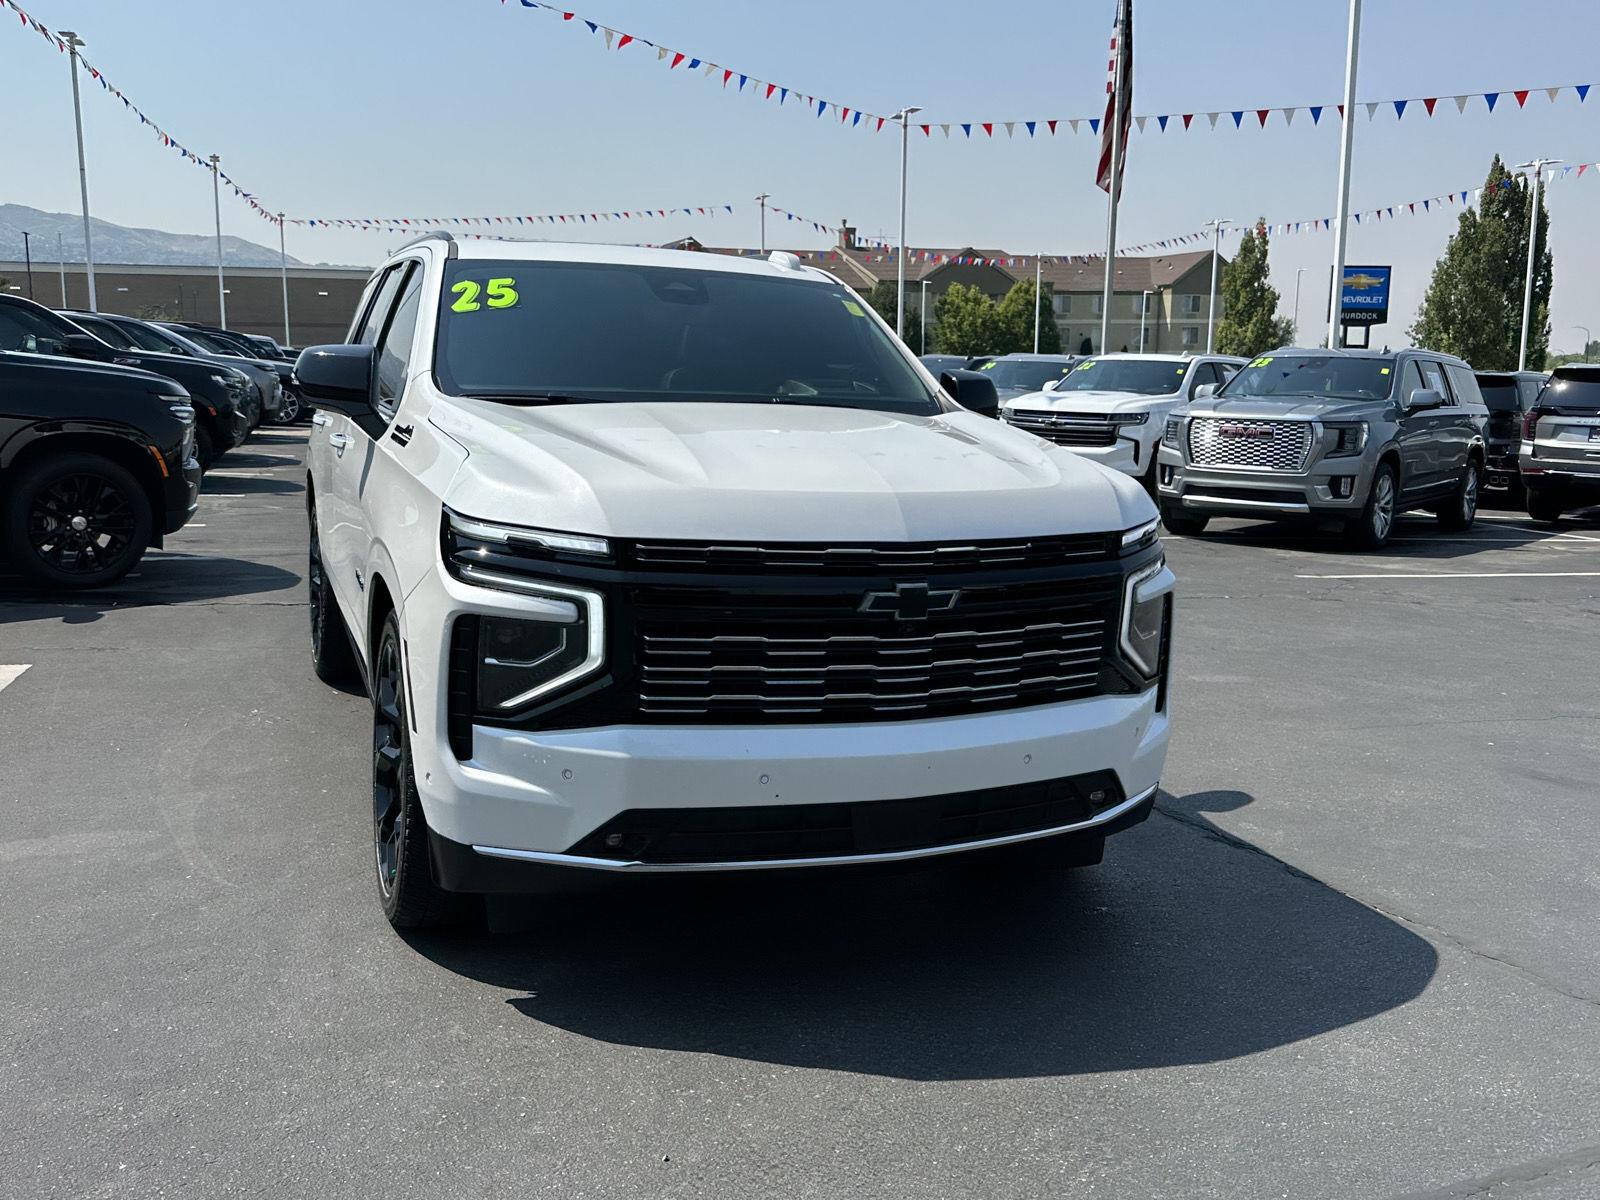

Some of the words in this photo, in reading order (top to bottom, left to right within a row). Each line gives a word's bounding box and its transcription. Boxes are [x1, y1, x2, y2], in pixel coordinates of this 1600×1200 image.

[451, 278, 519, 312] 25
[1341, 296, 1383, 304] HEVROLET
[1220, 427, 1273, 439] GMC
